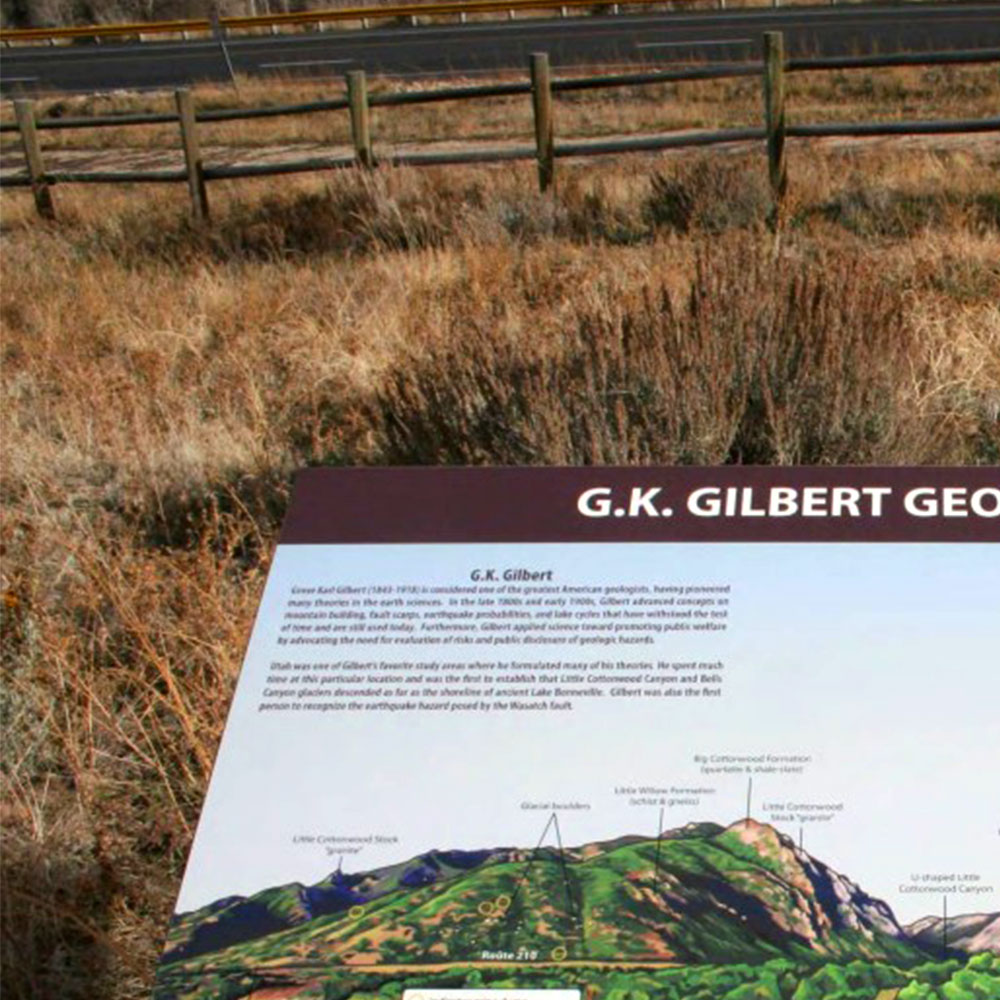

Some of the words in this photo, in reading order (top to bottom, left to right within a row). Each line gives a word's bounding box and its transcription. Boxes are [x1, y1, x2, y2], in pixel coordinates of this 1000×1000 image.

[577, 487, 673, 518] G.K.
[687, 486, 892, 518] GILBERT
[470, 569, 499, 582] G.K.
[502, 569, 553, 582] Gilbert
[481, 951, 515, 960] Route
[516, 951, 538, 960] 210
